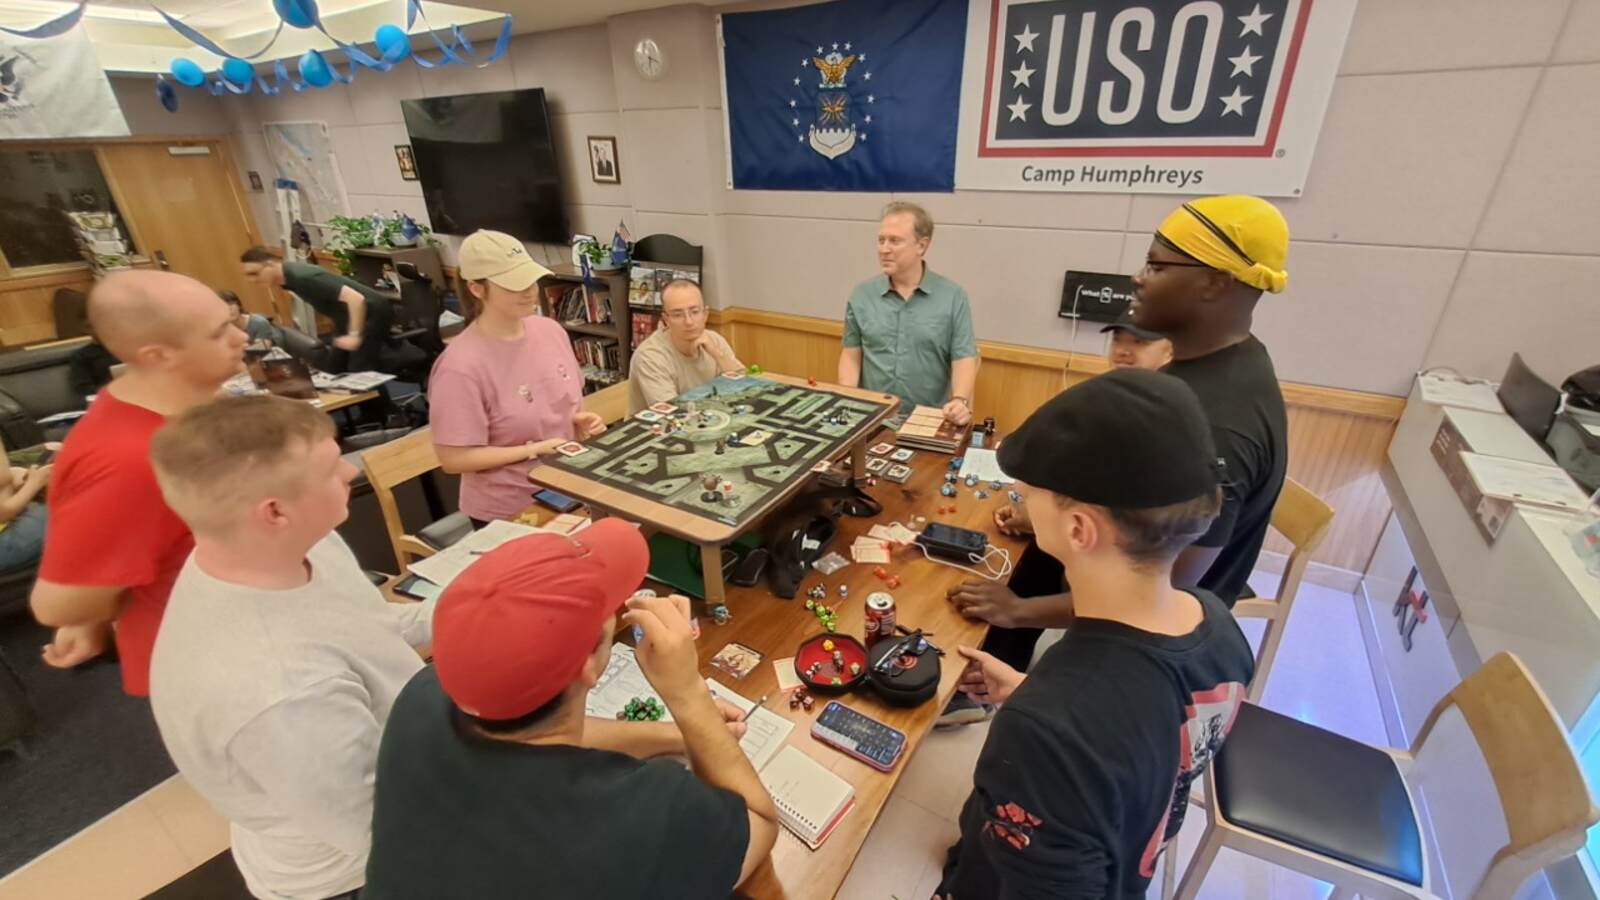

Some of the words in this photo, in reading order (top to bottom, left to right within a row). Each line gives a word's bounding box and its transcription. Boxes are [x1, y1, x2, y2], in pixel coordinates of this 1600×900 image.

[1041, 1, 1224, 127] USO
[1021, 165, 1075, 185] Camp
[1080, 165, 1203, 188] Humphreys
